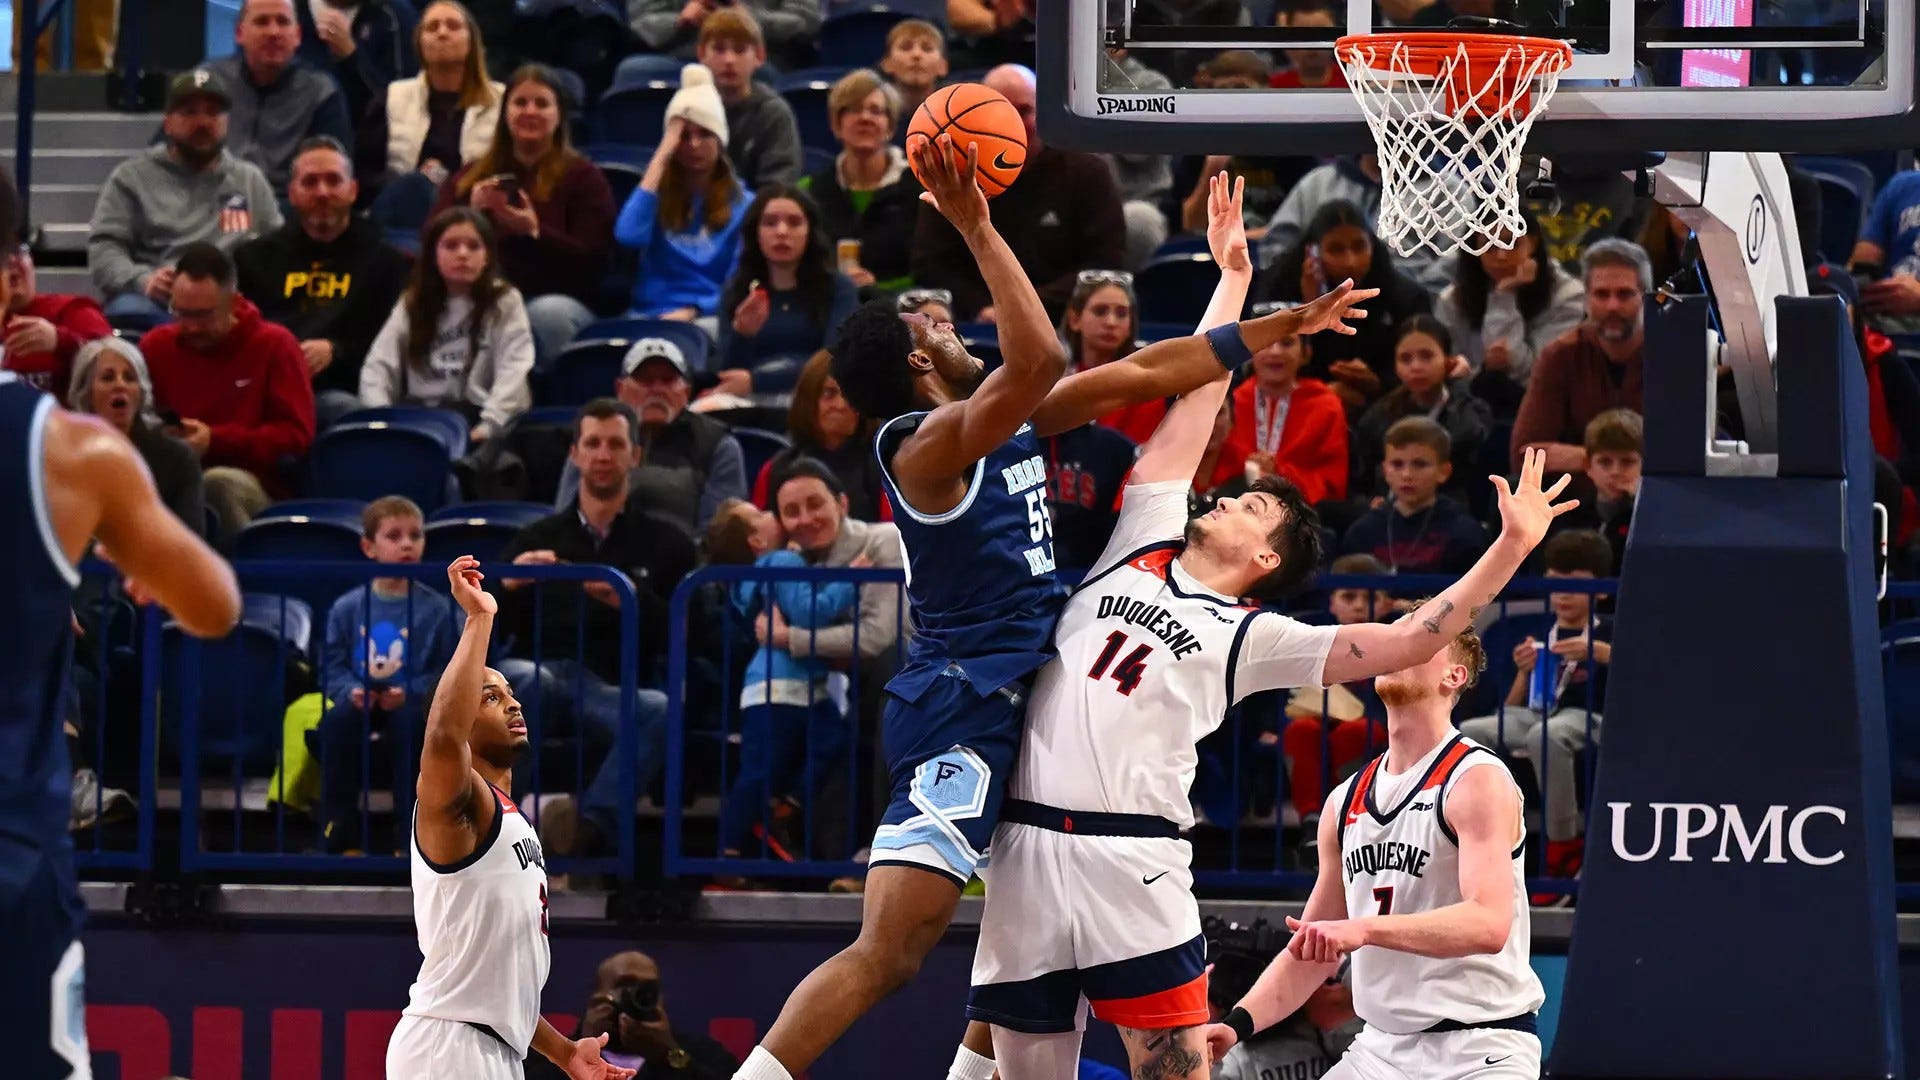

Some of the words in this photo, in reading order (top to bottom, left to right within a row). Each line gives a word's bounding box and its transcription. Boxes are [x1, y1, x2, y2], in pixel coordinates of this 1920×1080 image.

[1097, 96, 1175, 115] SPALDING
[284, 272, 352, 299] PGH
[1001, 455, 1046, 497] RHOD
[1096, 595, 1203, 662] DUQUESNE
[1087, 629, 1154, 697] 14
[1607, 802, 1846, 866] UPMC
[1345, 842, 1431, 884] DUQUESNE
[1373, 886, 1394, 916] 7
